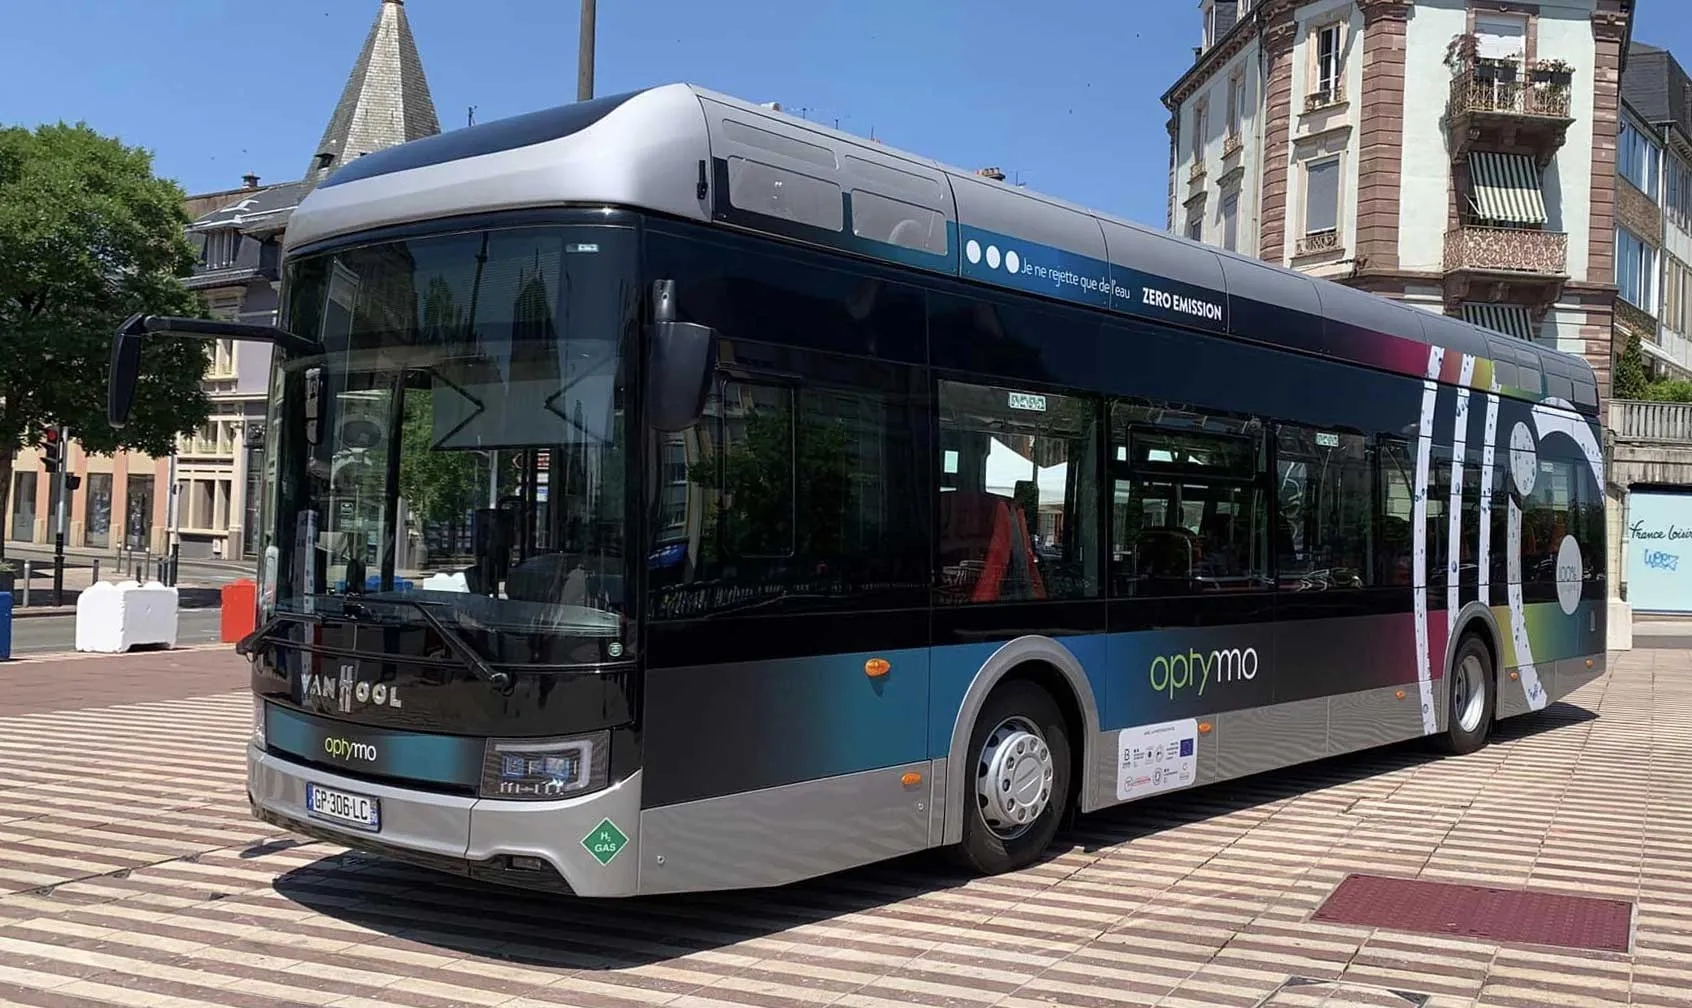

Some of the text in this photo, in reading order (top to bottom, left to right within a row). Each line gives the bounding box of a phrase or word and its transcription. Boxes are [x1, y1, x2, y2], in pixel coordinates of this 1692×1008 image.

[1021, 257, 1131, 299] Je ne rejette que de l'eau
[1142, 287, 1222, 321] ZERO EMISSION
[301, 665, 402, 713] VAN HOOL
[1149, 647, 1258, 700] optymo
[324, 737, 377, 761] optymo
[314, 789, 368, 820] GP-306-LC
[594, 843, 617, 852] GAS
